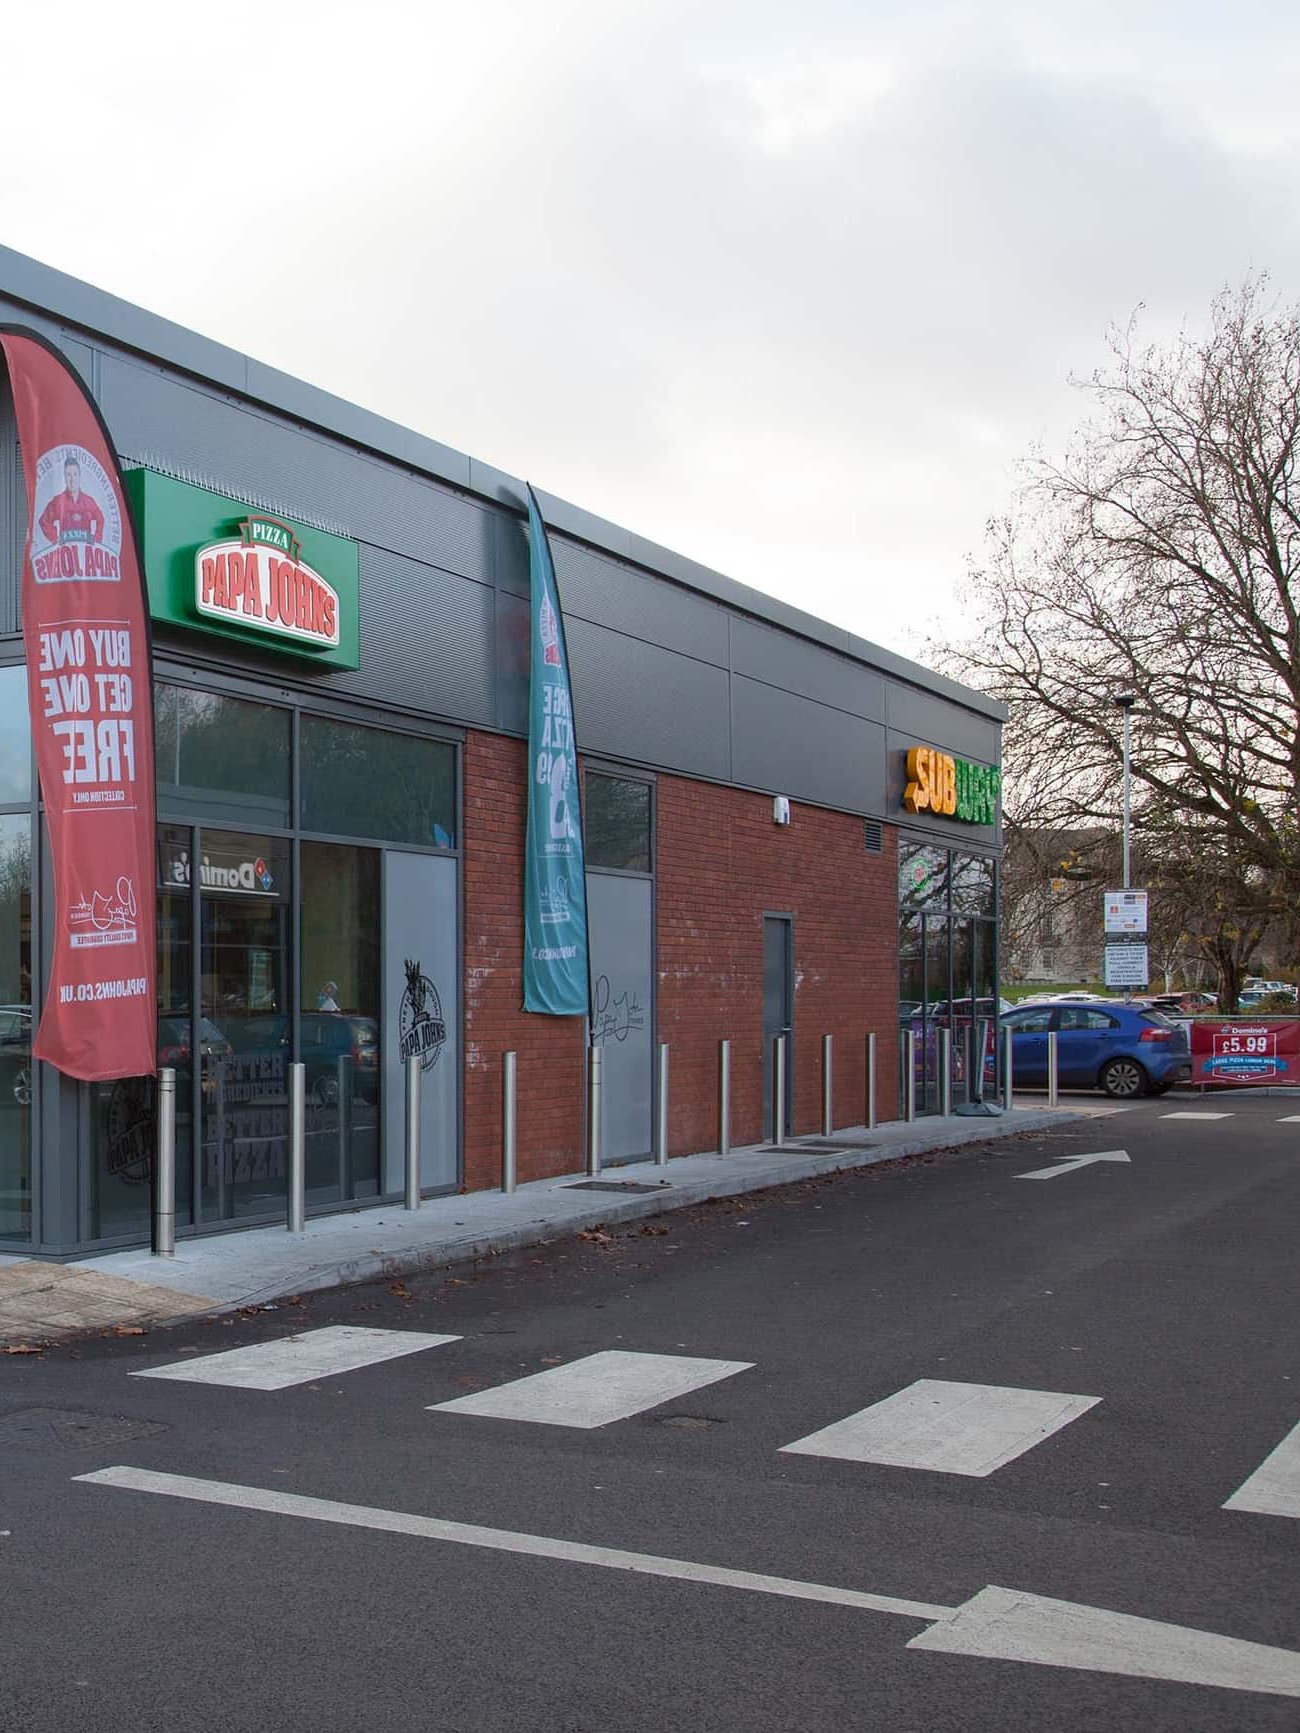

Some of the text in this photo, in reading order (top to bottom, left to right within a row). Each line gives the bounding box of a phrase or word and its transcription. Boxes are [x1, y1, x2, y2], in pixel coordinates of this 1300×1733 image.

[252, 522, 290, 550] PIZZA
[202, 551, 263, 618] PAPA
[904, 745, 1001, 825] SUBWAY
[400, 1028, 421, 1060] PAPA
[1222, 1036, 1268, 1054] £5.99
[1231, 1026, 1269, 1034] Domino's
